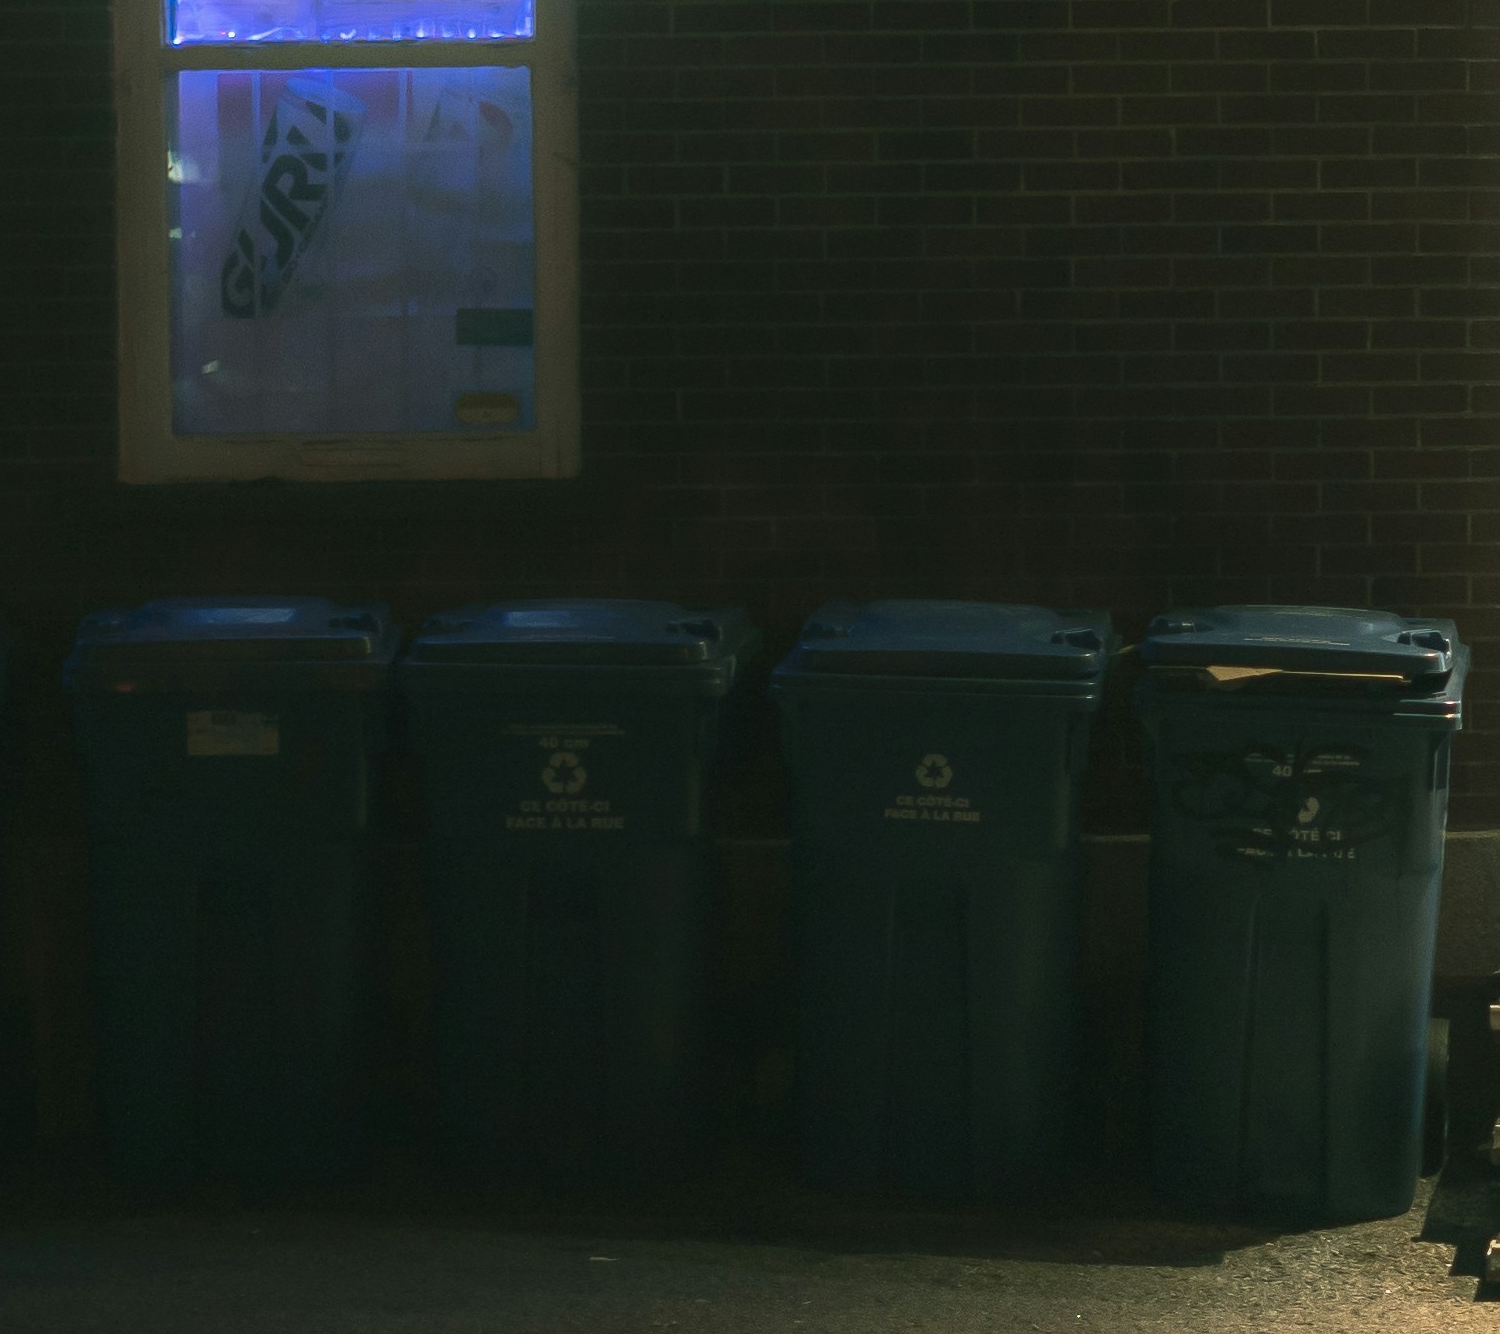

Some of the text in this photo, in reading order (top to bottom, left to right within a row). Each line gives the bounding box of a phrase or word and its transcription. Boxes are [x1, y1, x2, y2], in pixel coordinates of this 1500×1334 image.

[1271, 765, 1293, 778] 40
[519, 800, 541, 812] CE
[895, 795, 914, 806] CE
[884, 808, 917, 820] FACE
[933, 810, 950, 821] LA
[953, 811, 980, 822] RUE
[506, 815, 625, 829] FACE À LA RUE
